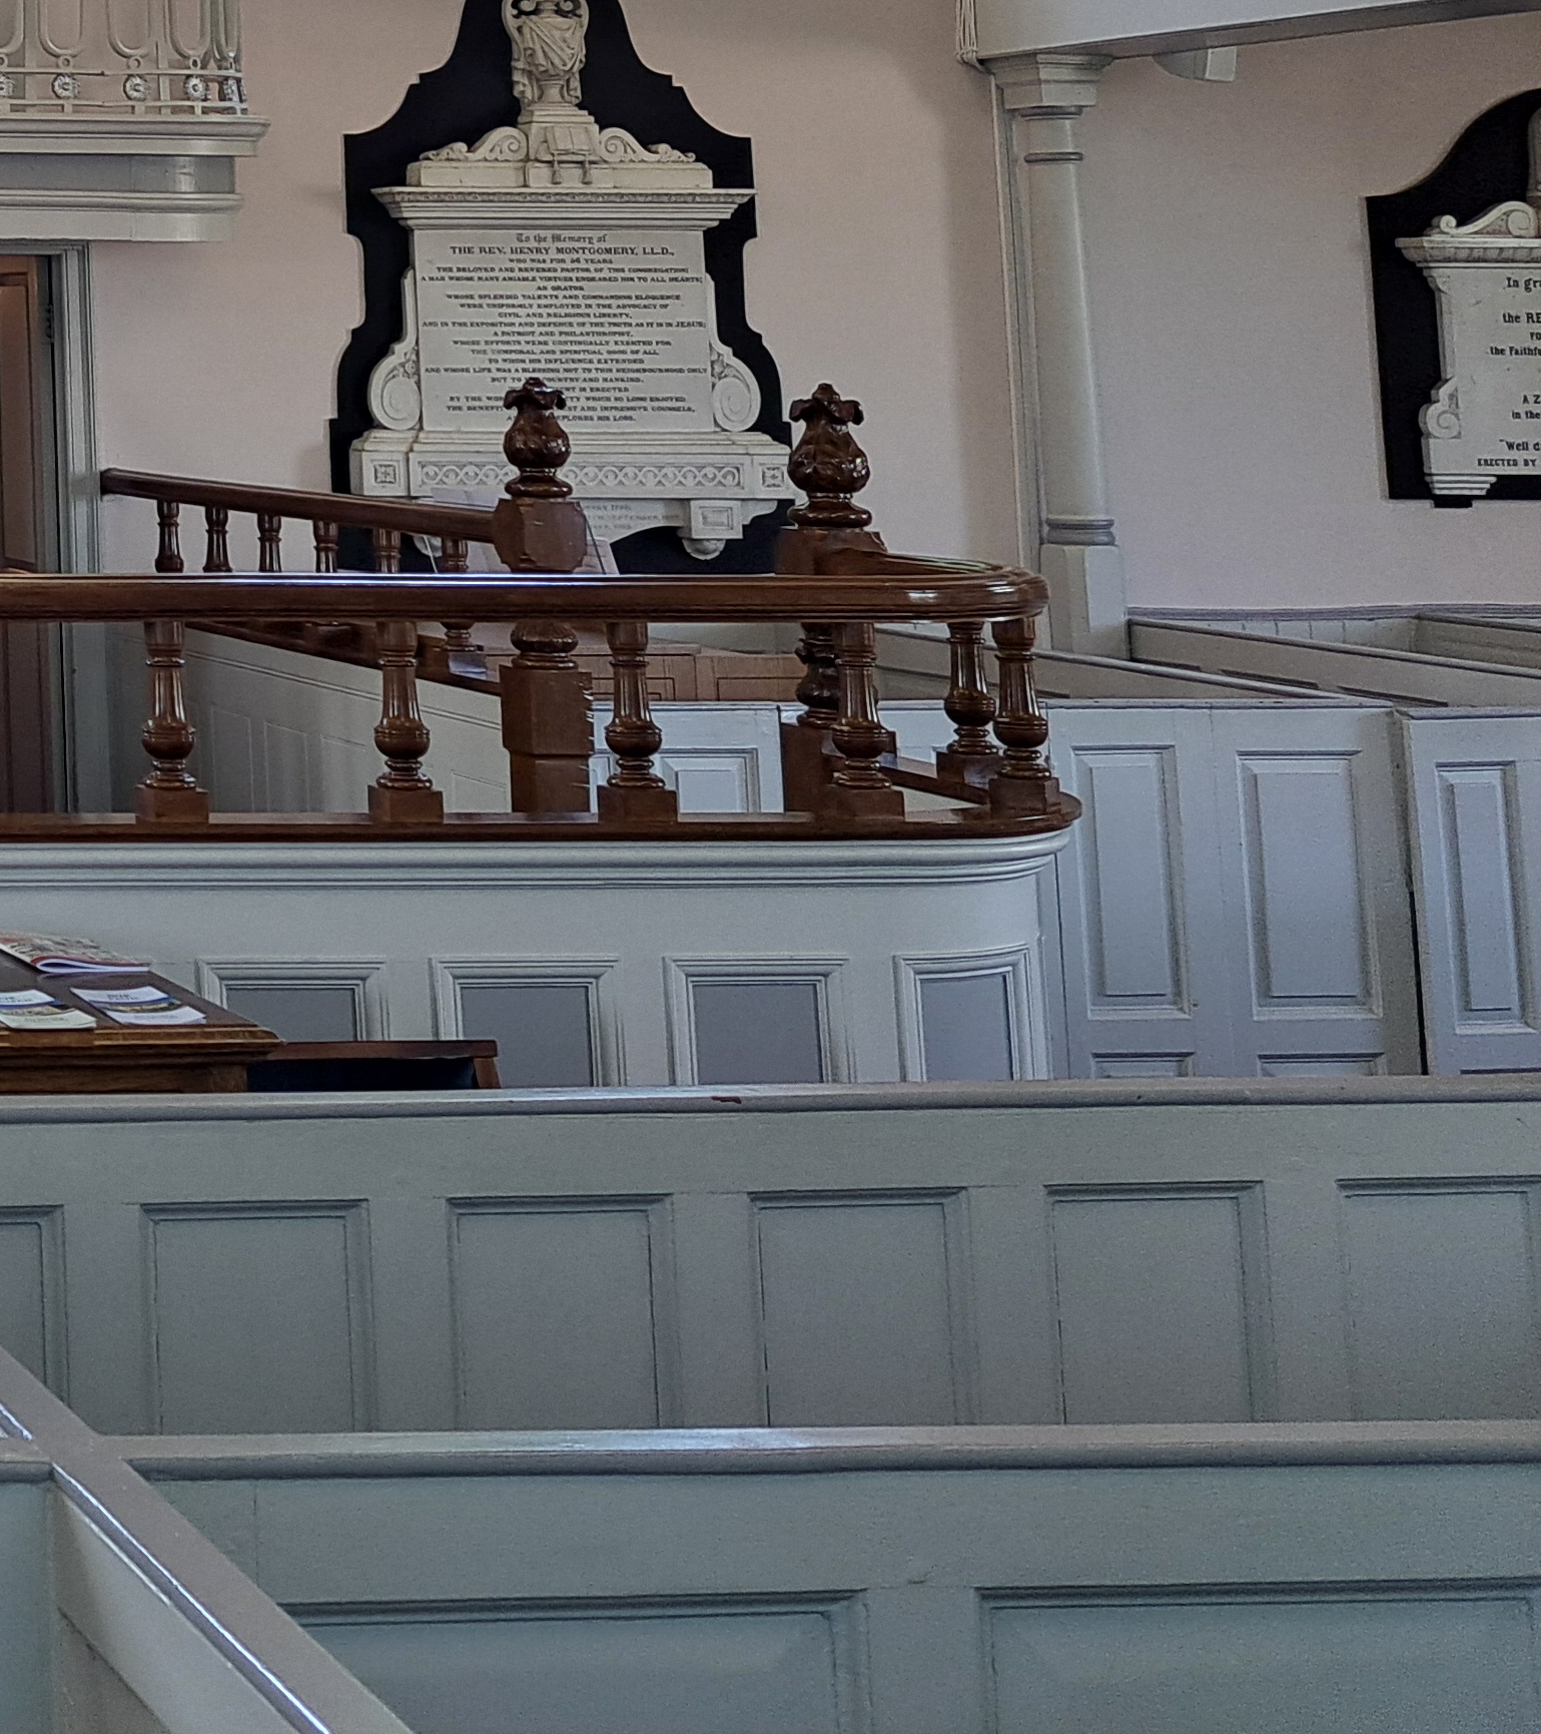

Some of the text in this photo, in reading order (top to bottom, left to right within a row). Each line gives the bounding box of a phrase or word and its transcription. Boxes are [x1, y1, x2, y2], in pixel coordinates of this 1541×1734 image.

[516, 233, 607, 245] To the Memory of
[450, 246, 474, 255] THE
[479, 246, 506, 255] REV.
[511, 246, 550, 255] HENRY
[556, 246, 638, 255] MONTGOMERY,
[1506, 277, 1541, 293] In gr
[1503, 312, 1521, 324] the
[1490, 346, 1505, 356] the
[1523, 394, 1540, 405] A Z
[1525, 410, 1540, 420] the
[1478, 458, 1536, 467] ERECTED BY
